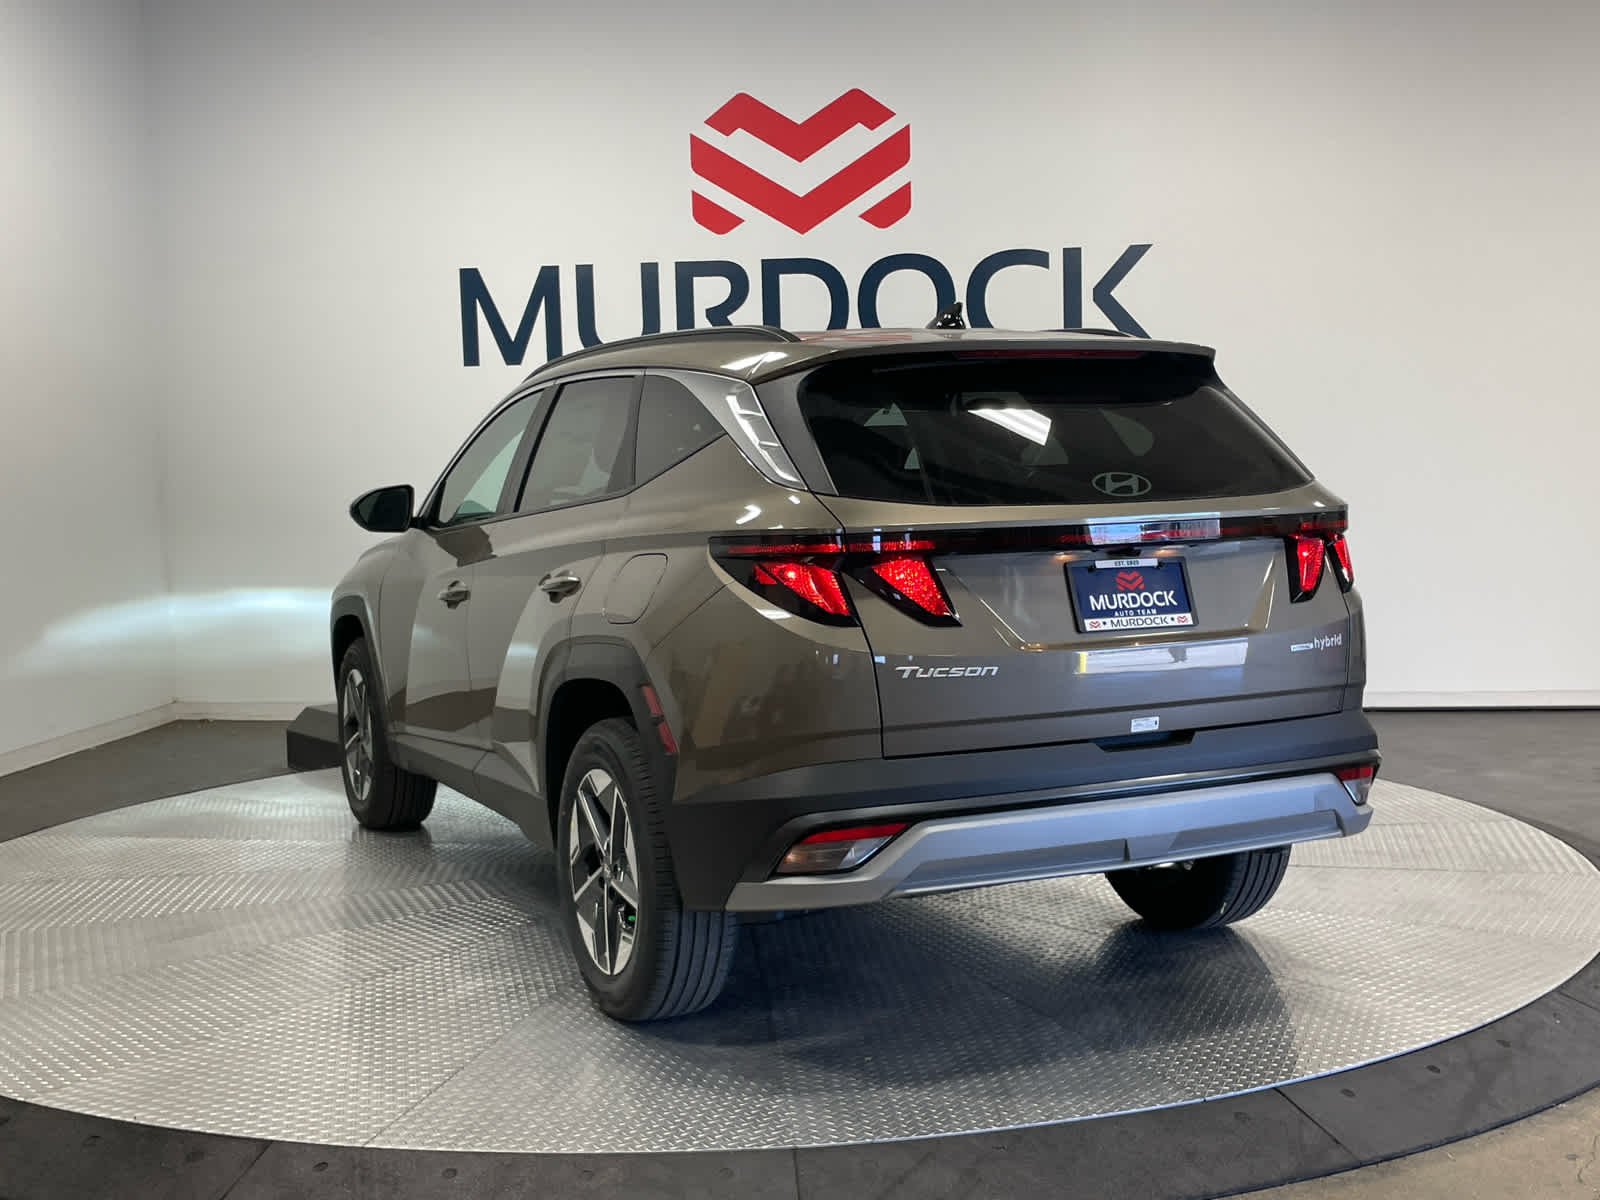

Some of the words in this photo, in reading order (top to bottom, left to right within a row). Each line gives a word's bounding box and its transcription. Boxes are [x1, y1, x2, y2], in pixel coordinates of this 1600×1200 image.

[459, 243, 1153, 367] MURDOCK
[1089, 590, 1178, 611] MURDOCK
[1110, 616, 1169, 628] MURDOCK
[1114, 609, 1135, 617] AUTO
[1137, 608, 1157, 616] TEAM
[1313, 632, 1342, 651] hybrid
